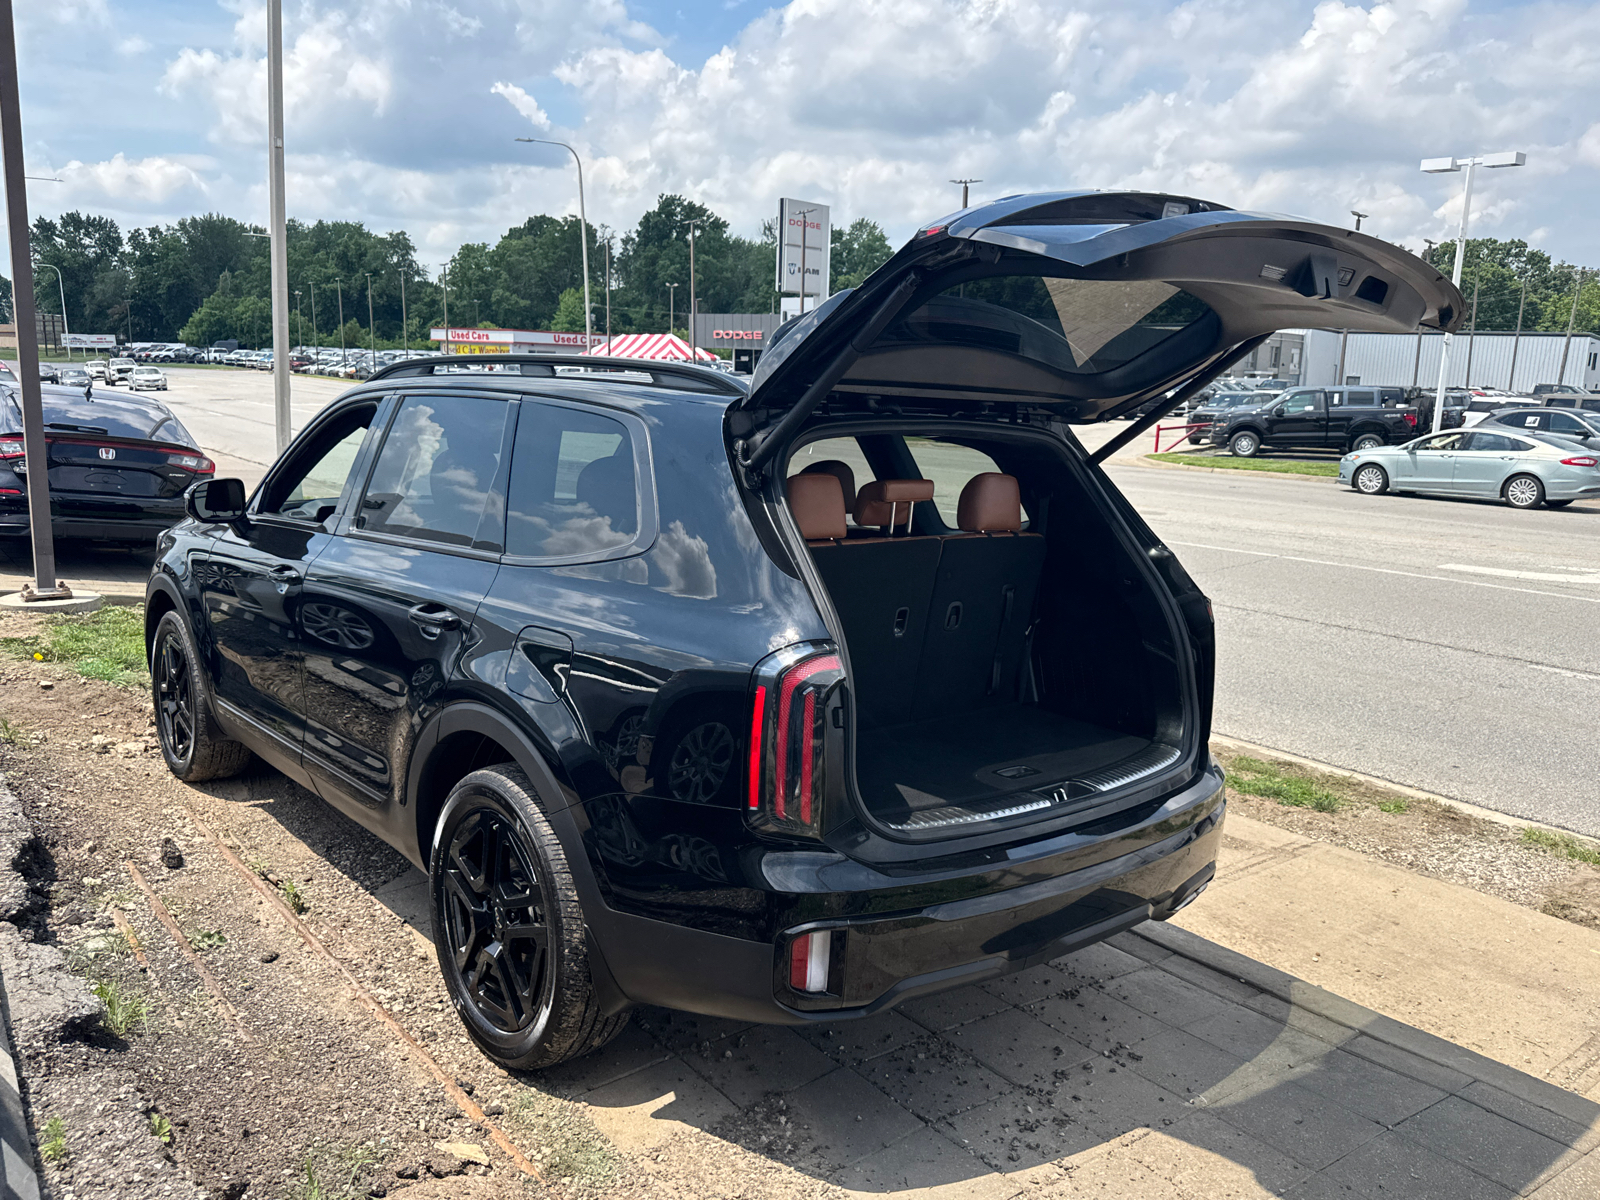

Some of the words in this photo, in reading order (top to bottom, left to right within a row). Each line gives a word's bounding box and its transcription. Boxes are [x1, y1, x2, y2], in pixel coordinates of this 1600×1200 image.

[789, 219, 821, 230] DODGE
[450, 330, 470, 340] Used
[471, 331, 490, 340] Cars
[553, 334, 578, 344] Used
[580, 335, 602, 344] Crs
[713, 330, 763, 340] DODGE
